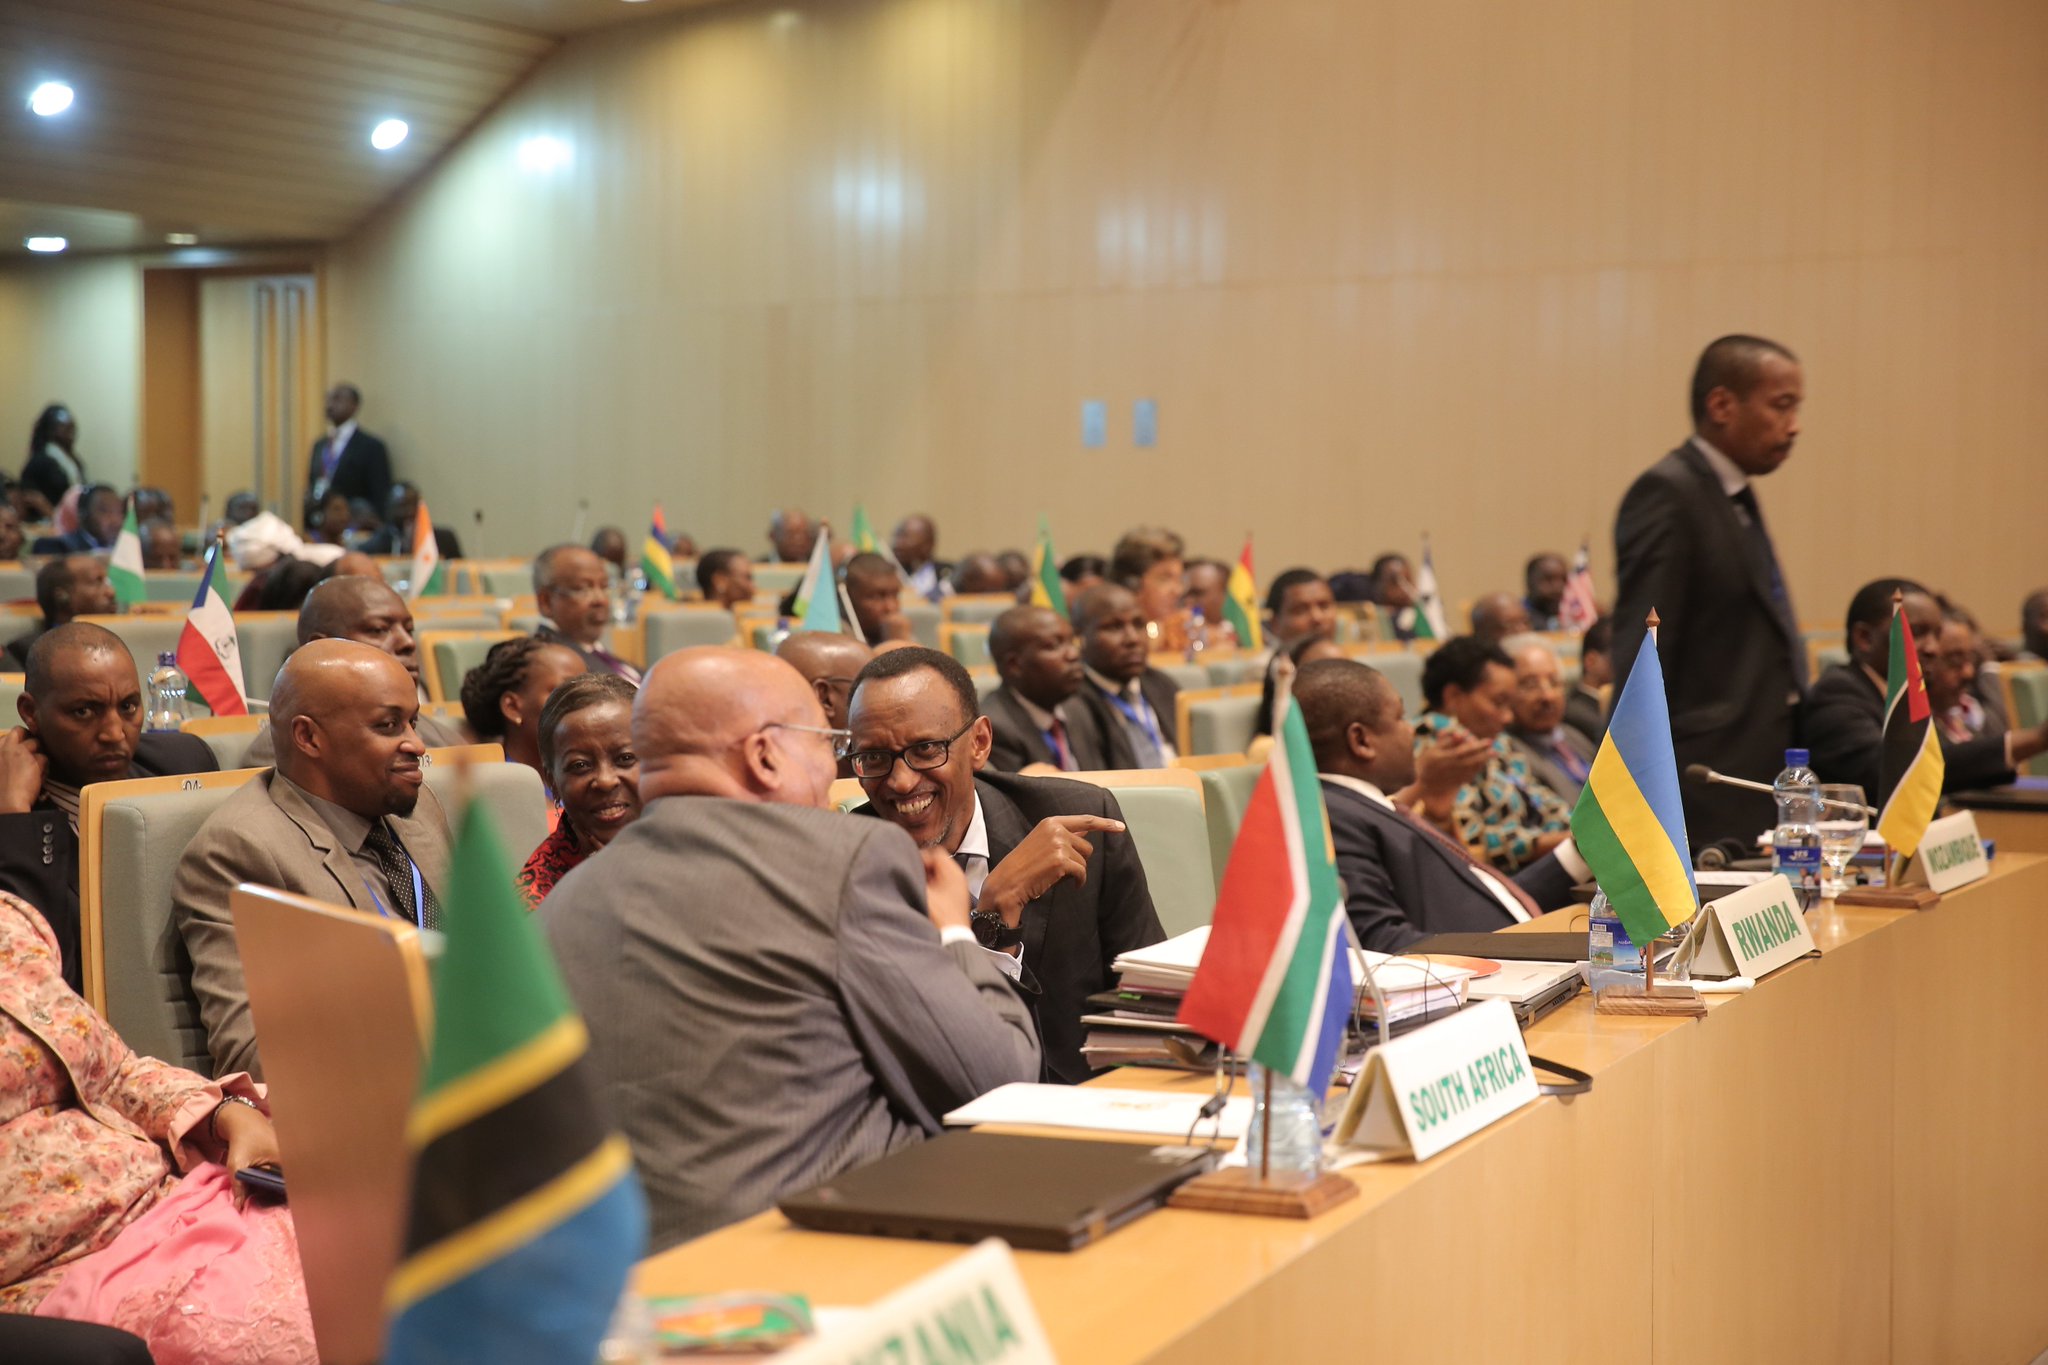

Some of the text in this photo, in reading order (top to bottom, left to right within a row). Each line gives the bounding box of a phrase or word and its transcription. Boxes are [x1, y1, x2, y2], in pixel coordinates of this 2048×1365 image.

[1732, 901, 1801, 961] RWANDA
[1409, 1043, 1526, 1131] SOUTH AFRICA
